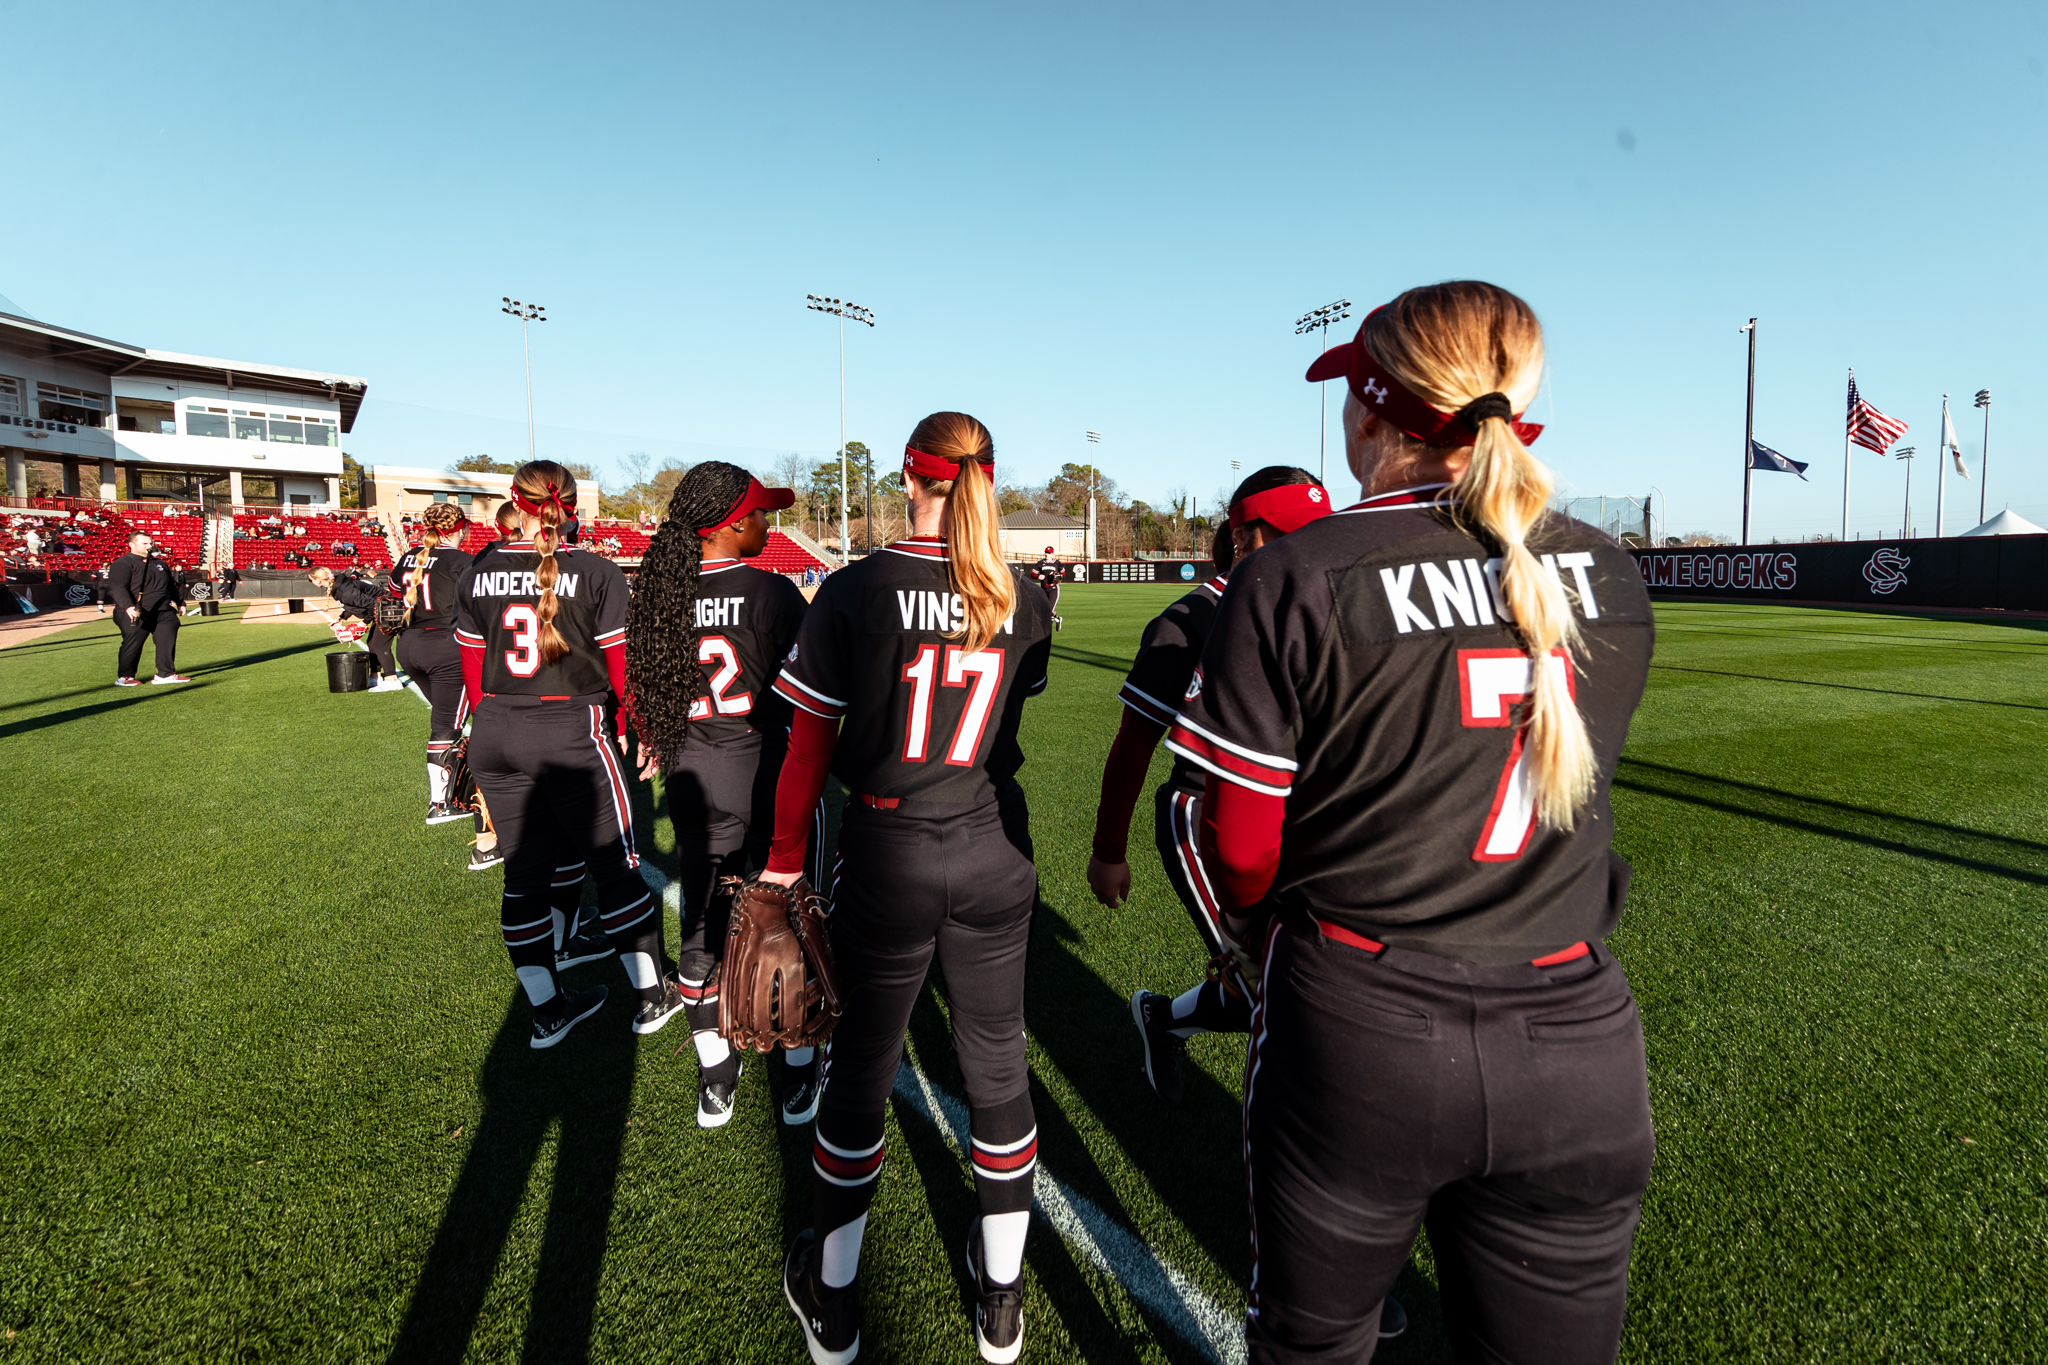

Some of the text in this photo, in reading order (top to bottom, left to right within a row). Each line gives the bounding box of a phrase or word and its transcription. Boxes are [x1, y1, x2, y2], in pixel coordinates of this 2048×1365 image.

[402, 571, 433, 611] 31
[1379, 551, 1599, 634] KNIT
[1634, 552, 1796, 590] AMECOCKS
[502, 603, 541, 678] 3
[694, 597, 745, 628] IGHT
[896, 590, 1013, 635] VINS
[687, 635, 754, 721] 2
[901, 643, 1005, 767] 17
[1456, 648, 1576, 863] 7
